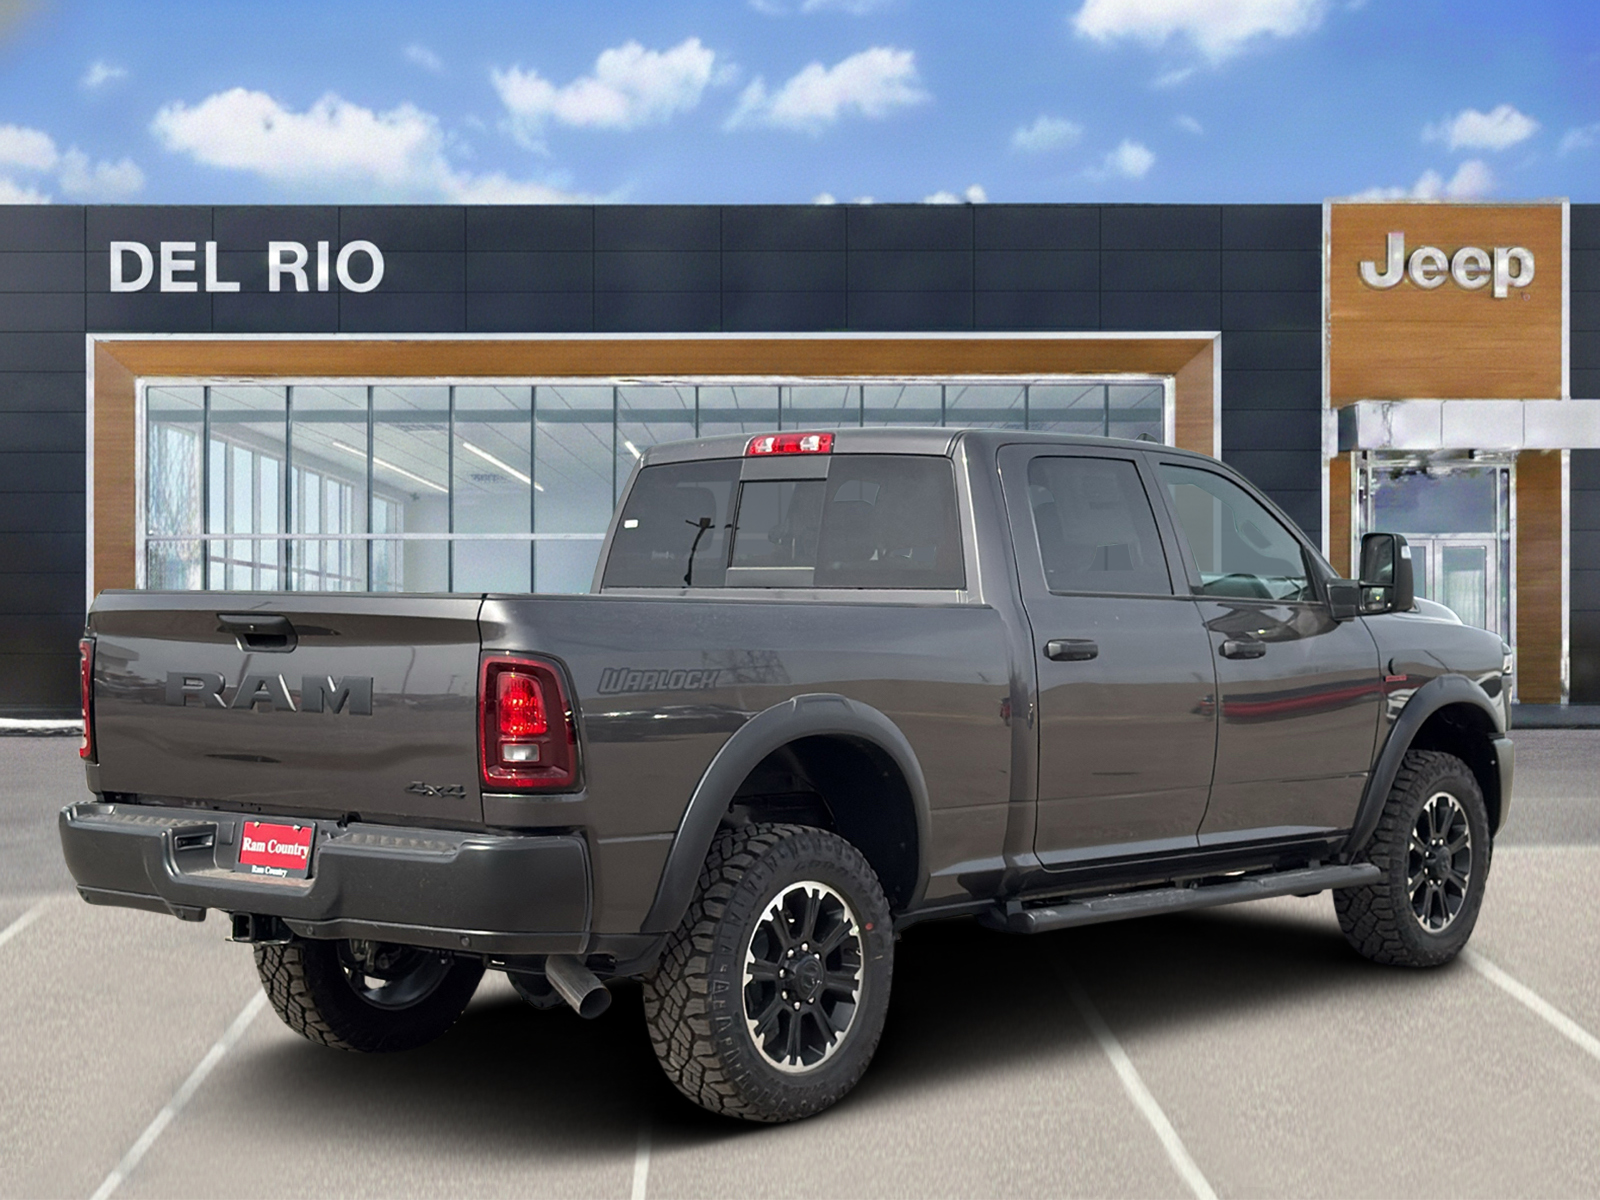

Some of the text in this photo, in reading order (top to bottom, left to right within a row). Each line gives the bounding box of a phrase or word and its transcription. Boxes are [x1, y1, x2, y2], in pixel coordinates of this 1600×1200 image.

[110, 240, 385, 293] DEL RIO
[1360, 231, 1535, 298] Jeep
[165, 671, 374, 715] RAM
[597, 668, 721, 694] WARLOCK
[242, 836, 310, 860] Ram Country
